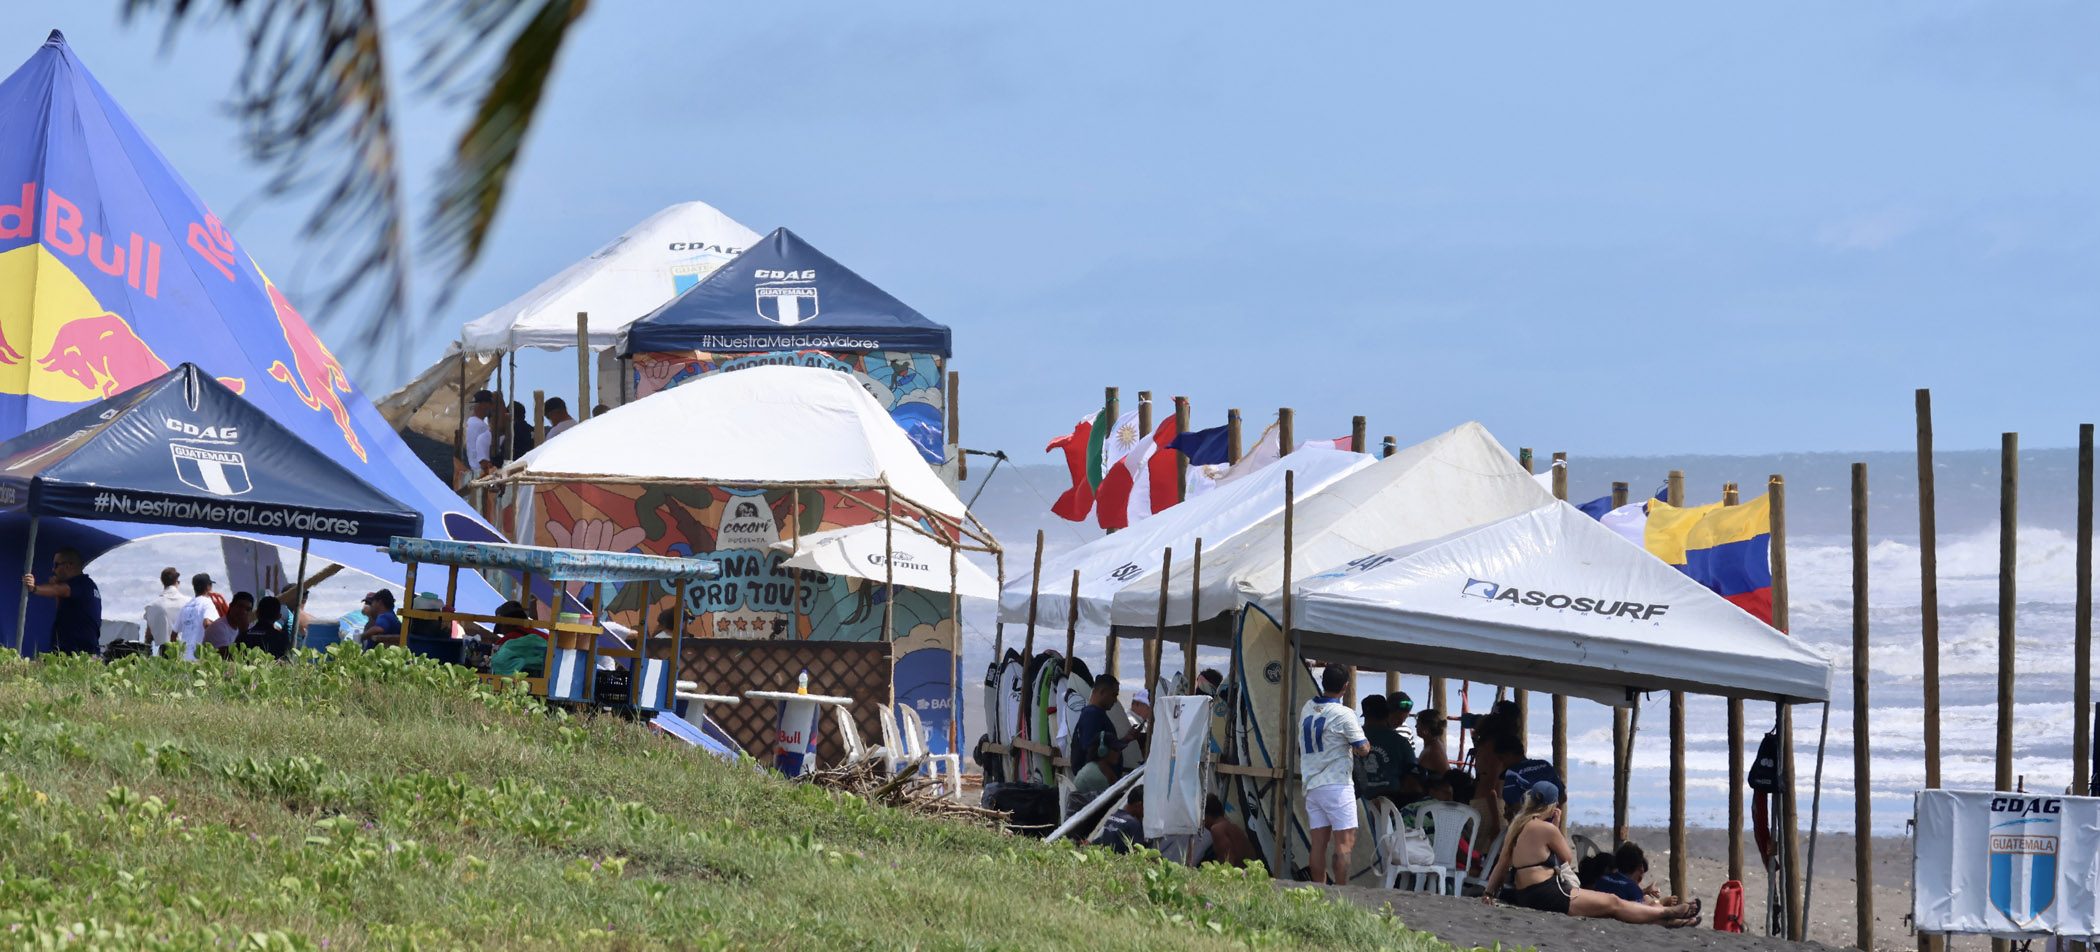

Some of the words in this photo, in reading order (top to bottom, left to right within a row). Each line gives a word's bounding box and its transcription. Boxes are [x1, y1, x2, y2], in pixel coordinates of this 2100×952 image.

[44, 189, 162, 299] Bull
[669, 242, 743, 255] CDAG
[754, 269, 816, 281] CDAG
[760, 288, 814, 296] GUATEMALA
[701, 335, 880, 350] #NuestraMetaLosValores
[166, 418, 238, 439] CDAG
[174, 447, 240, 463] GUATEMALA
[94, 492, 360, 537] #NuestraMetaLosValores
[867, 552, 929, 571] Crona
[689, 583, 738, 609] PRO
[747, 582, 812, 608] TOUR
[1495, 587, 1670, 621] ASOSURF
[778, 730, 801, 744] Bull
[1303, 714, 1327, 754] 11
[1990, 797, 2062, 817] CDAG
[1992, 838, 2054, 852] GUATEMALA
